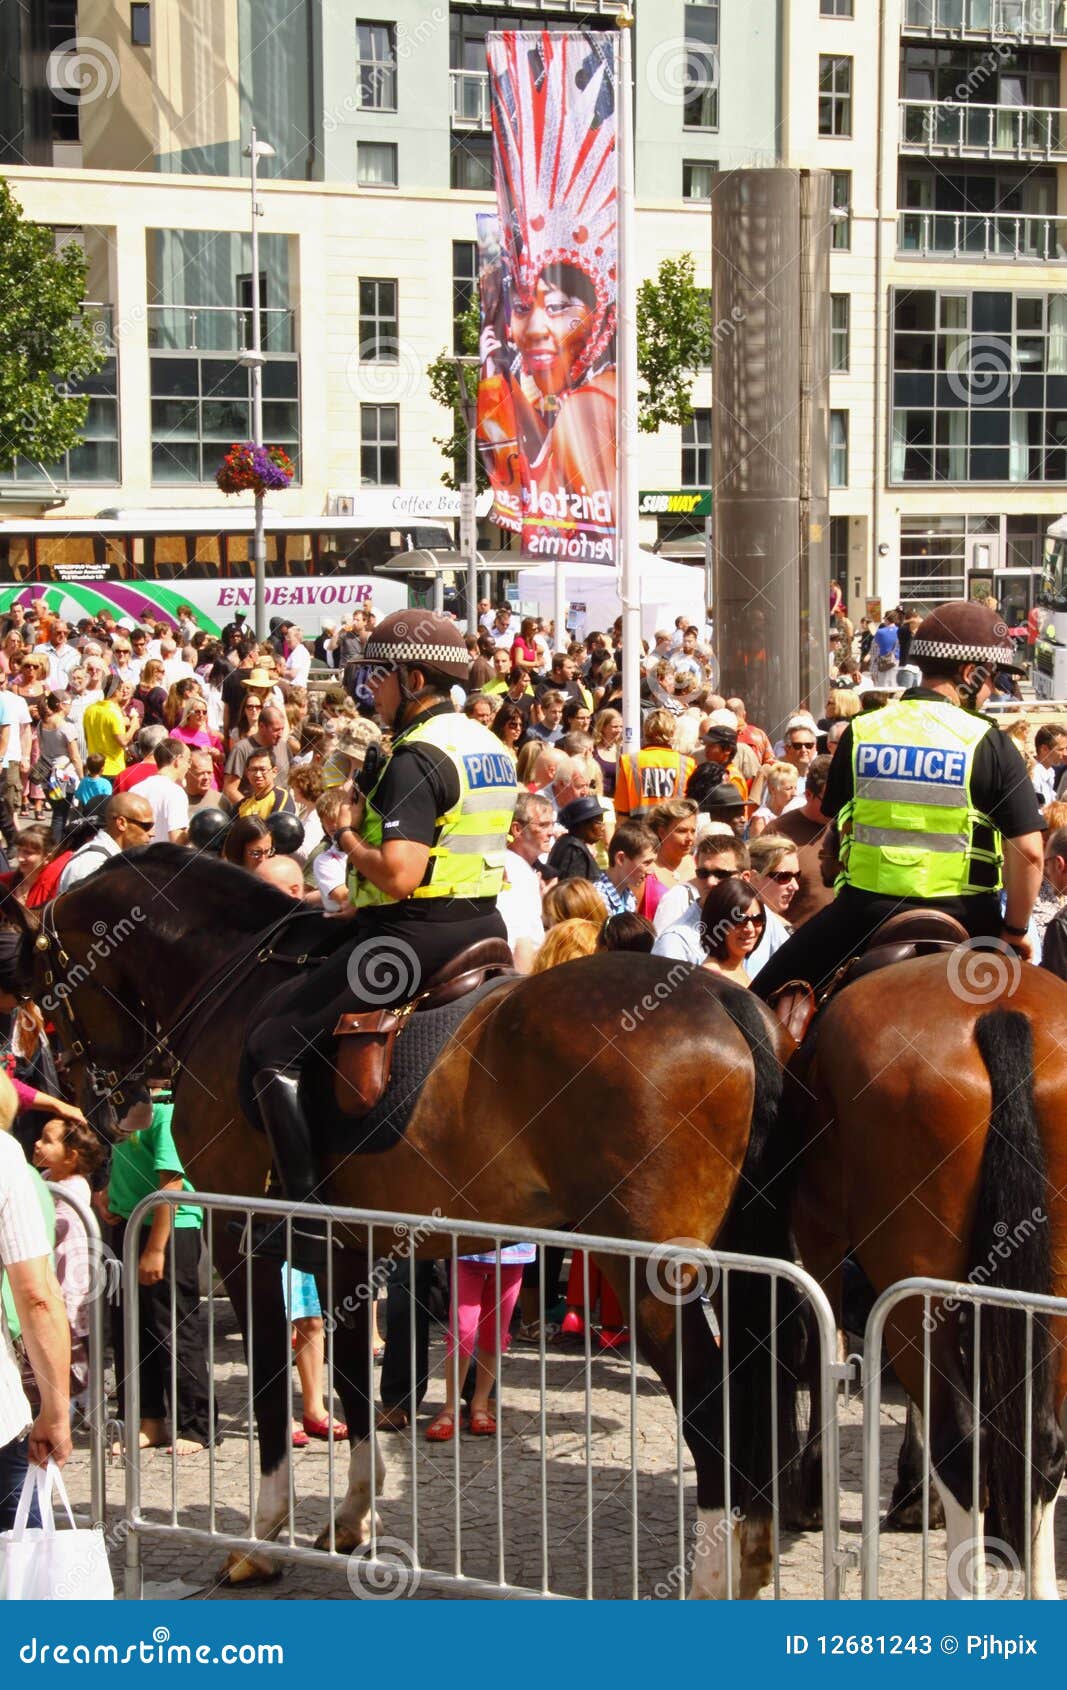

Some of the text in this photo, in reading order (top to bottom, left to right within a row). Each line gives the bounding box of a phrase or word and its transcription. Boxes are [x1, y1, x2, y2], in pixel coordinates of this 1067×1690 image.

[392, 496, 432, 513] Coffee
[639, 494, 702, 512] SUBWAY
[859, 746, 963, 781] POLICE
